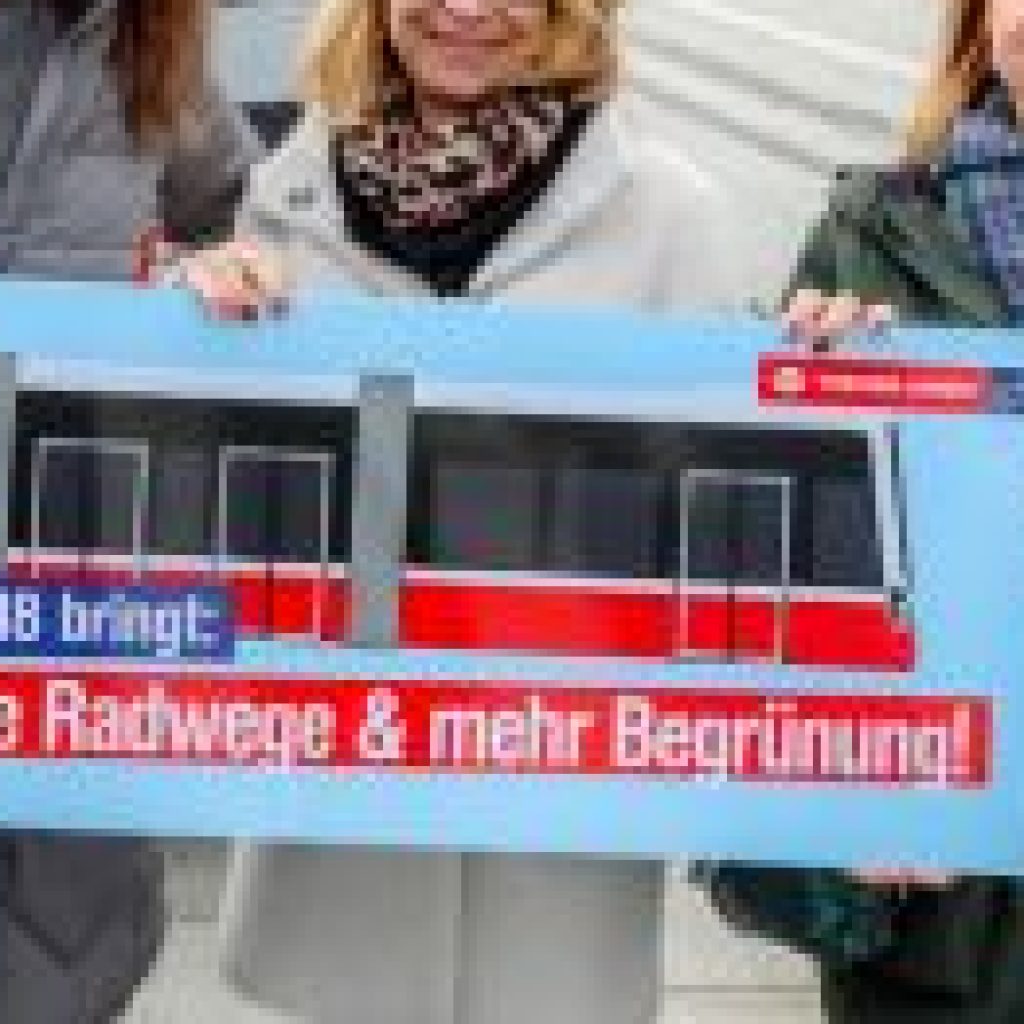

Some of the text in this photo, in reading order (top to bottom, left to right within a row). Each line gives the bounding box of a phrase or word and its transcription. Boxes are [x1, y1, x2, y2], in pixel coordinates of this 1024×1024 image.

[60, 590, 220, 660] bringt:
[42, 678, 334, 770] Radwege
[358, 688, 402, 764] &
[428, 696, 592, 770] mehr
[614, 694, 972, 790] Begrünung!
